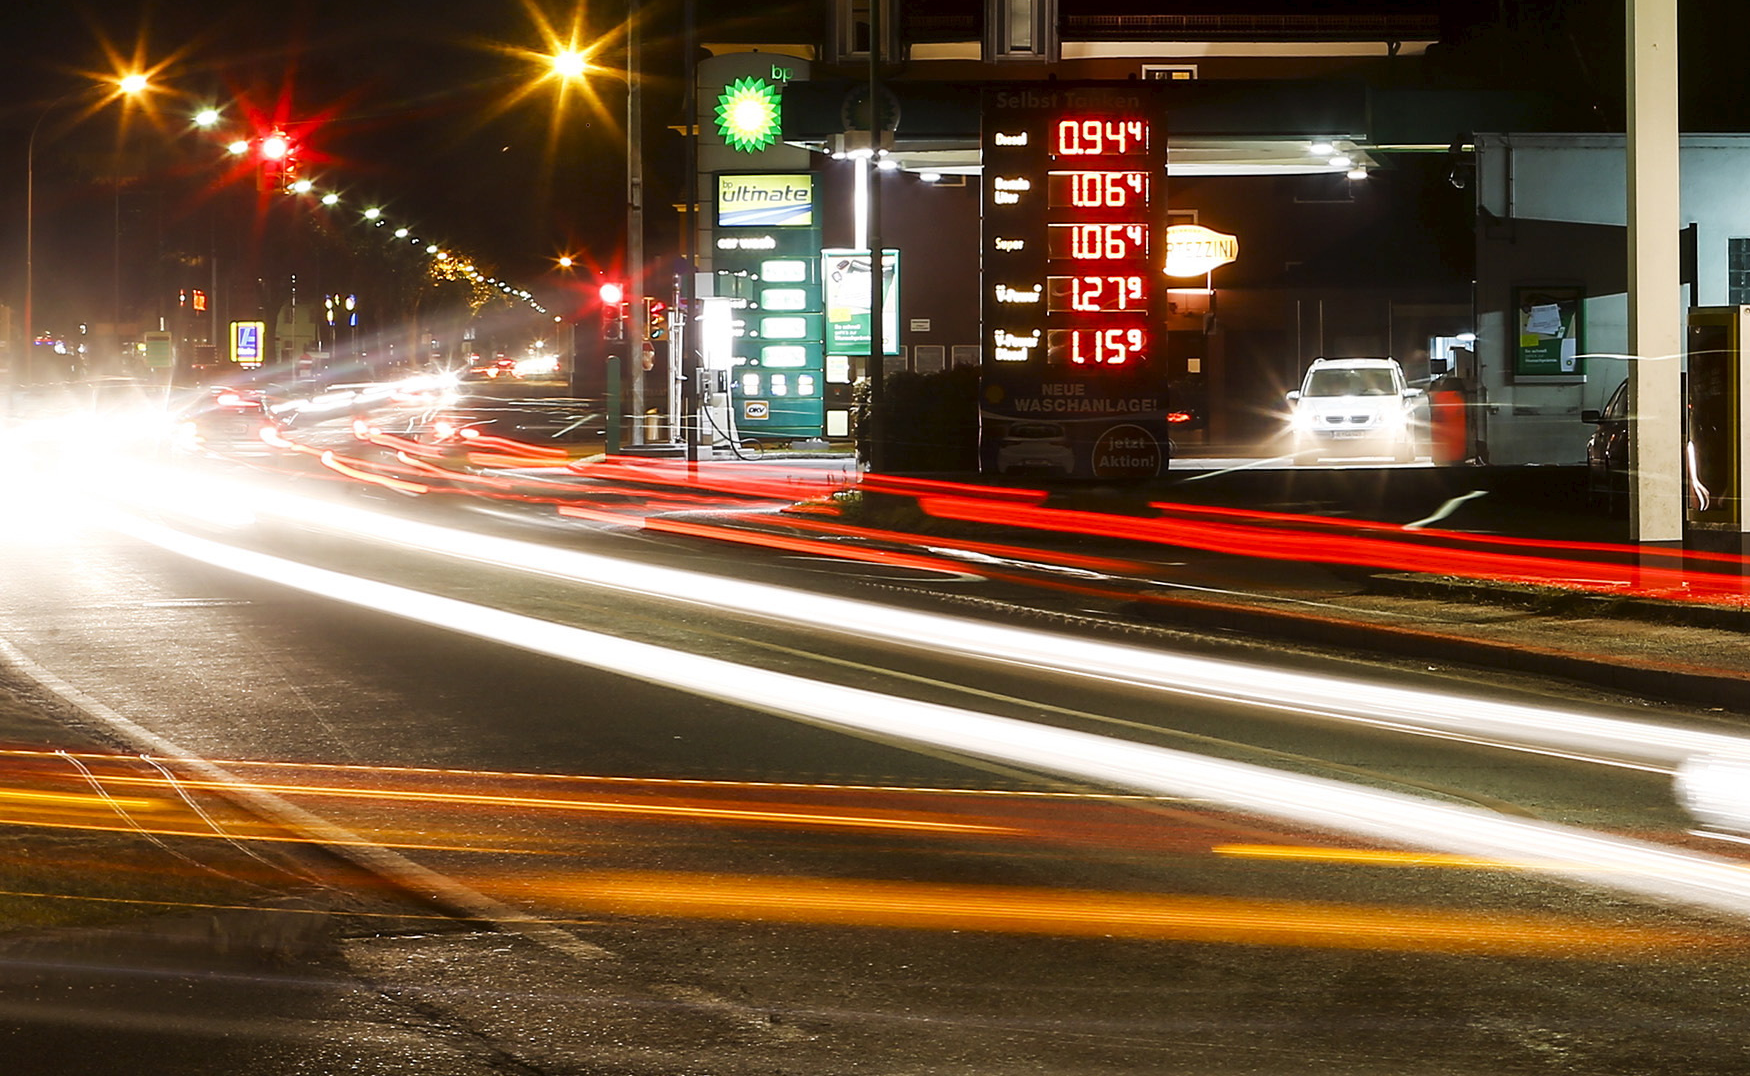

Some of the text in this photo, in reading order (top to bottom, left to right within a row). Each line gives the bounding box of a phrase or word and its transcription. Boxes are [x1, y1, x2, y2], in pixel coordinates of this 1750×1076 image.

[771, 64, 794, 83] bp
[996, 91, 1140, 109] Selbst Tanken
[722, 180, 733, 190] bp
[722, 185, 809, 203] ultimate
[995, 237, 1025, 252] Super
[1166, 241, 1233, 260] RTEZZINI
[1042, 383, 1085, 396] NEUE
[1014, 398, 1157, 412] WASCHANLAGE!
[1109, 436, 1145, 451] jetzt
[1099, 455, 1154, 467] Aktion!
